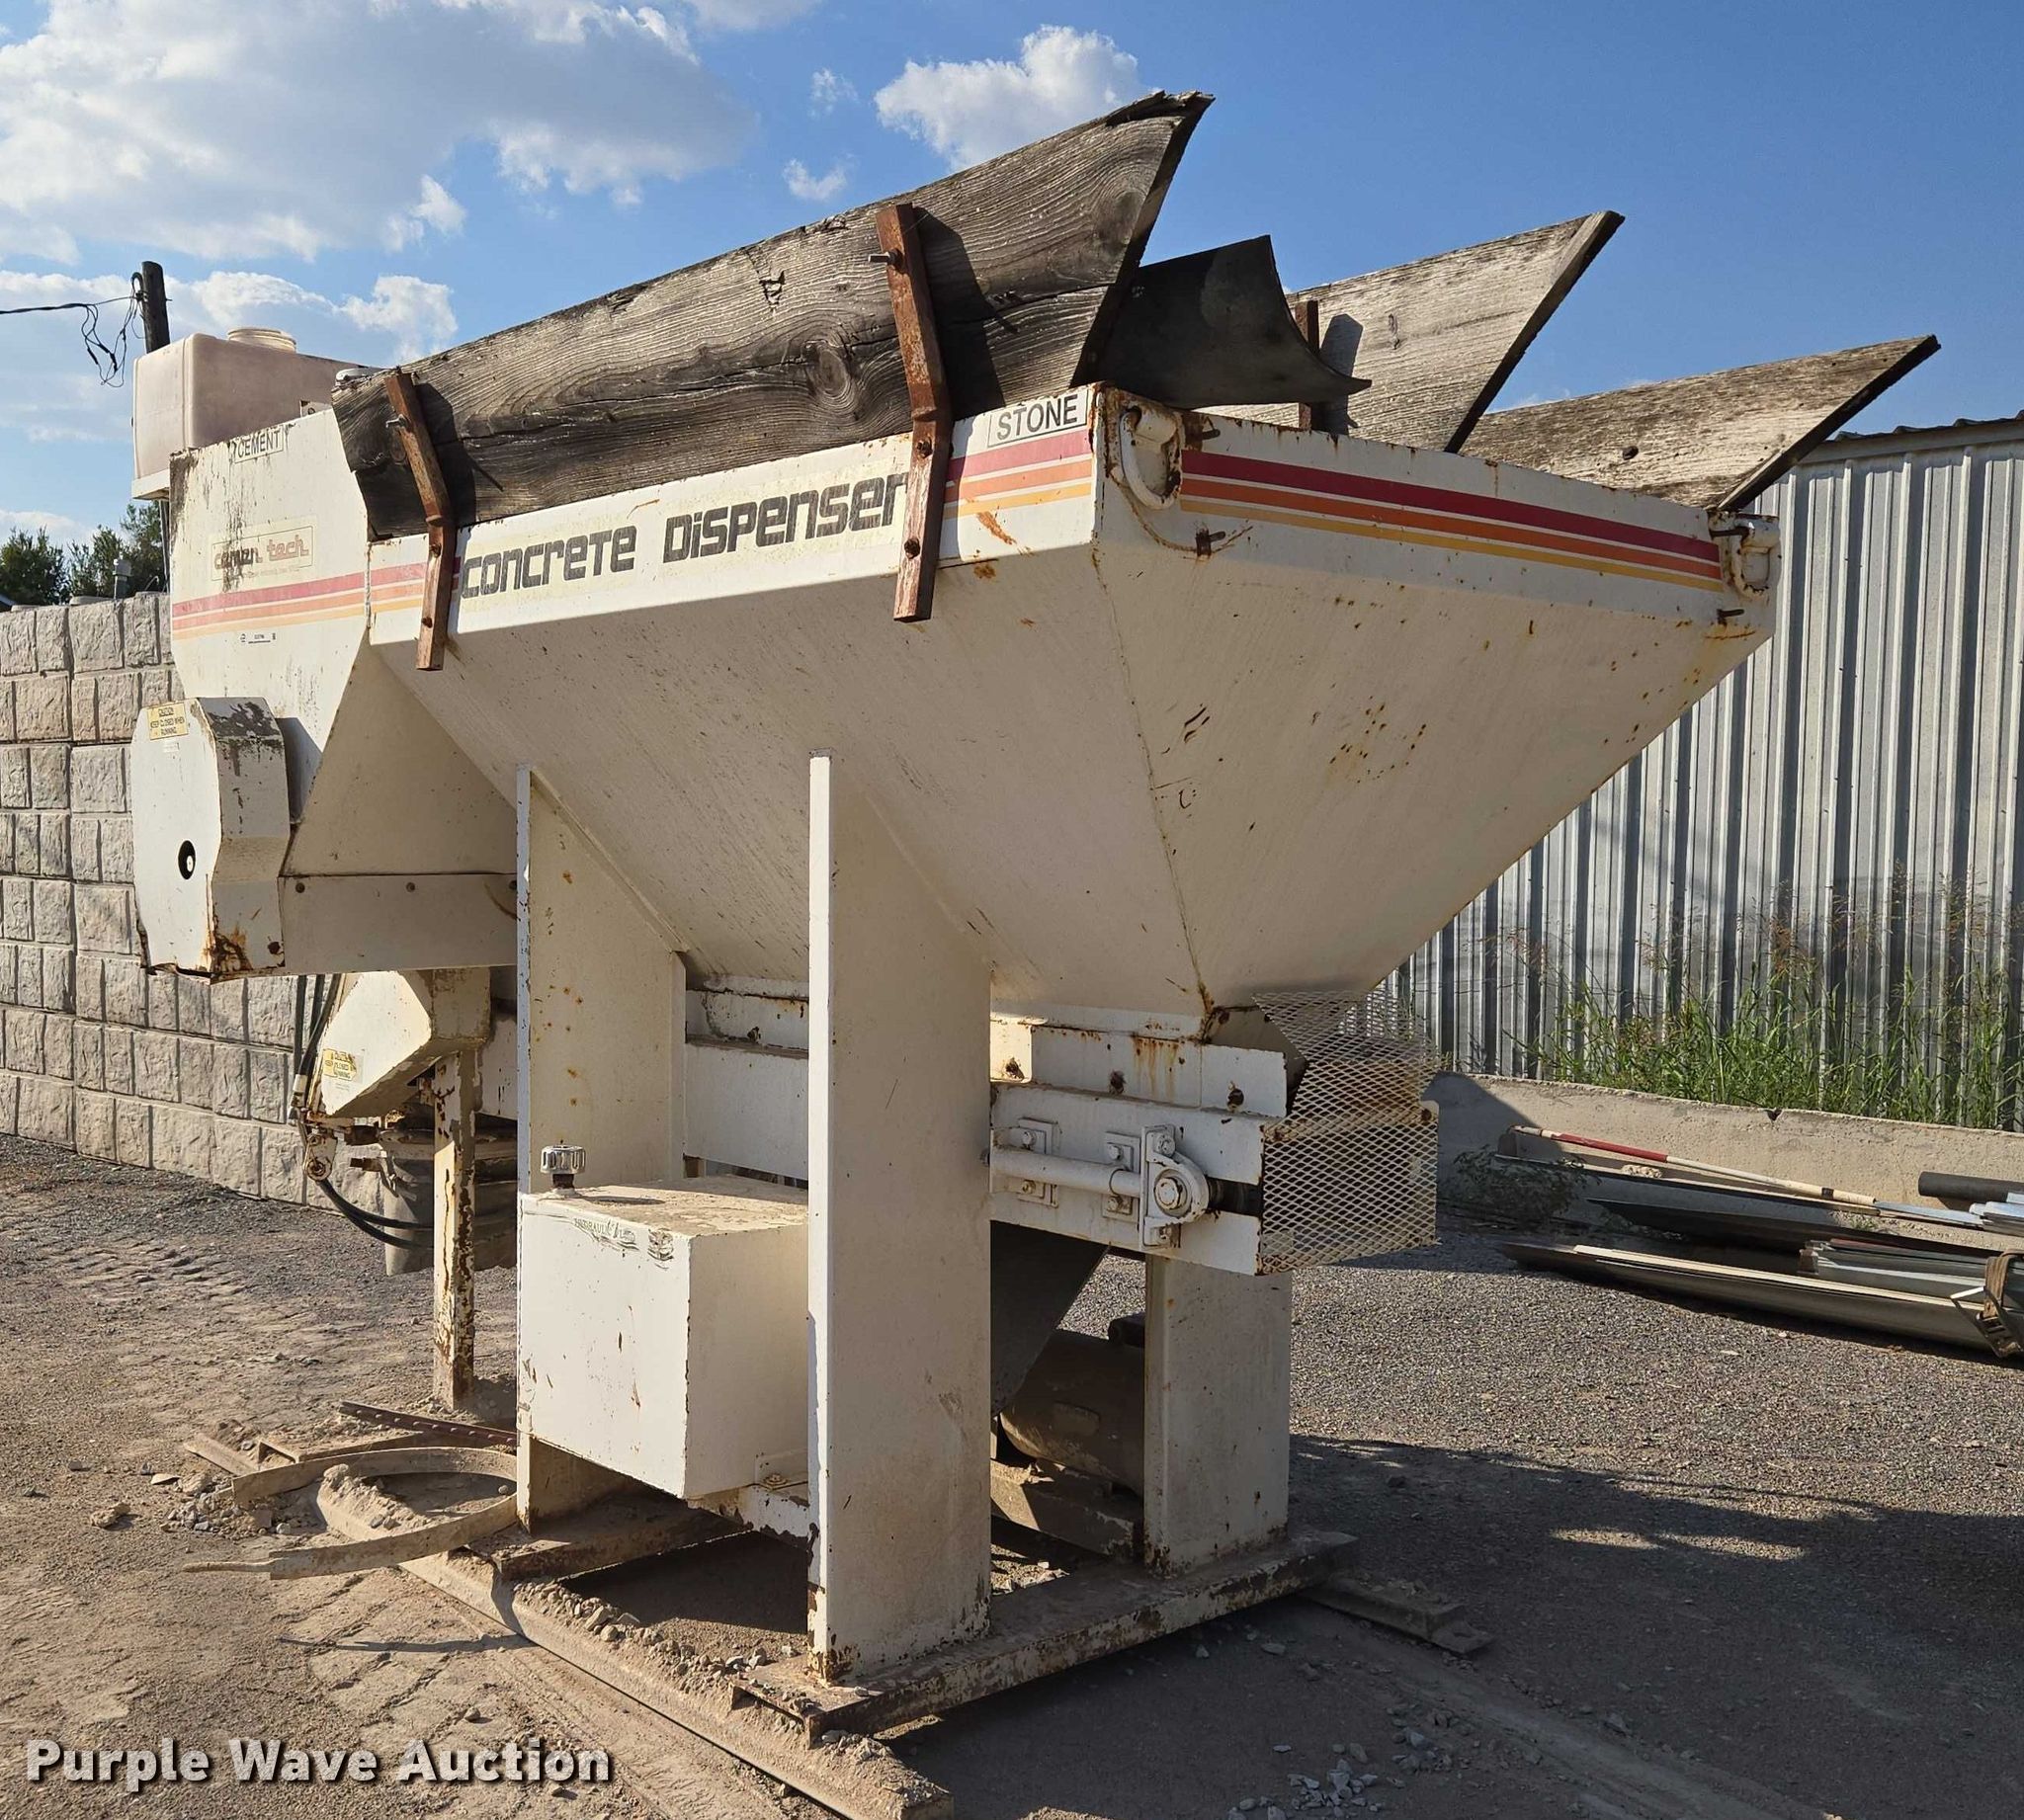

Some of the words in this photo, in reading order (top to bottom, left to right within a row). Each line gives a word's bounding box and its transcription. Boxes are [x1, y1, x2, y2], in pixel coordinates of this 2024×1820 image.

[997, 394, 1078, 441] STONE
[237, 430, 281, 458] CEMENT
[266, 534, 309, 561] tech
